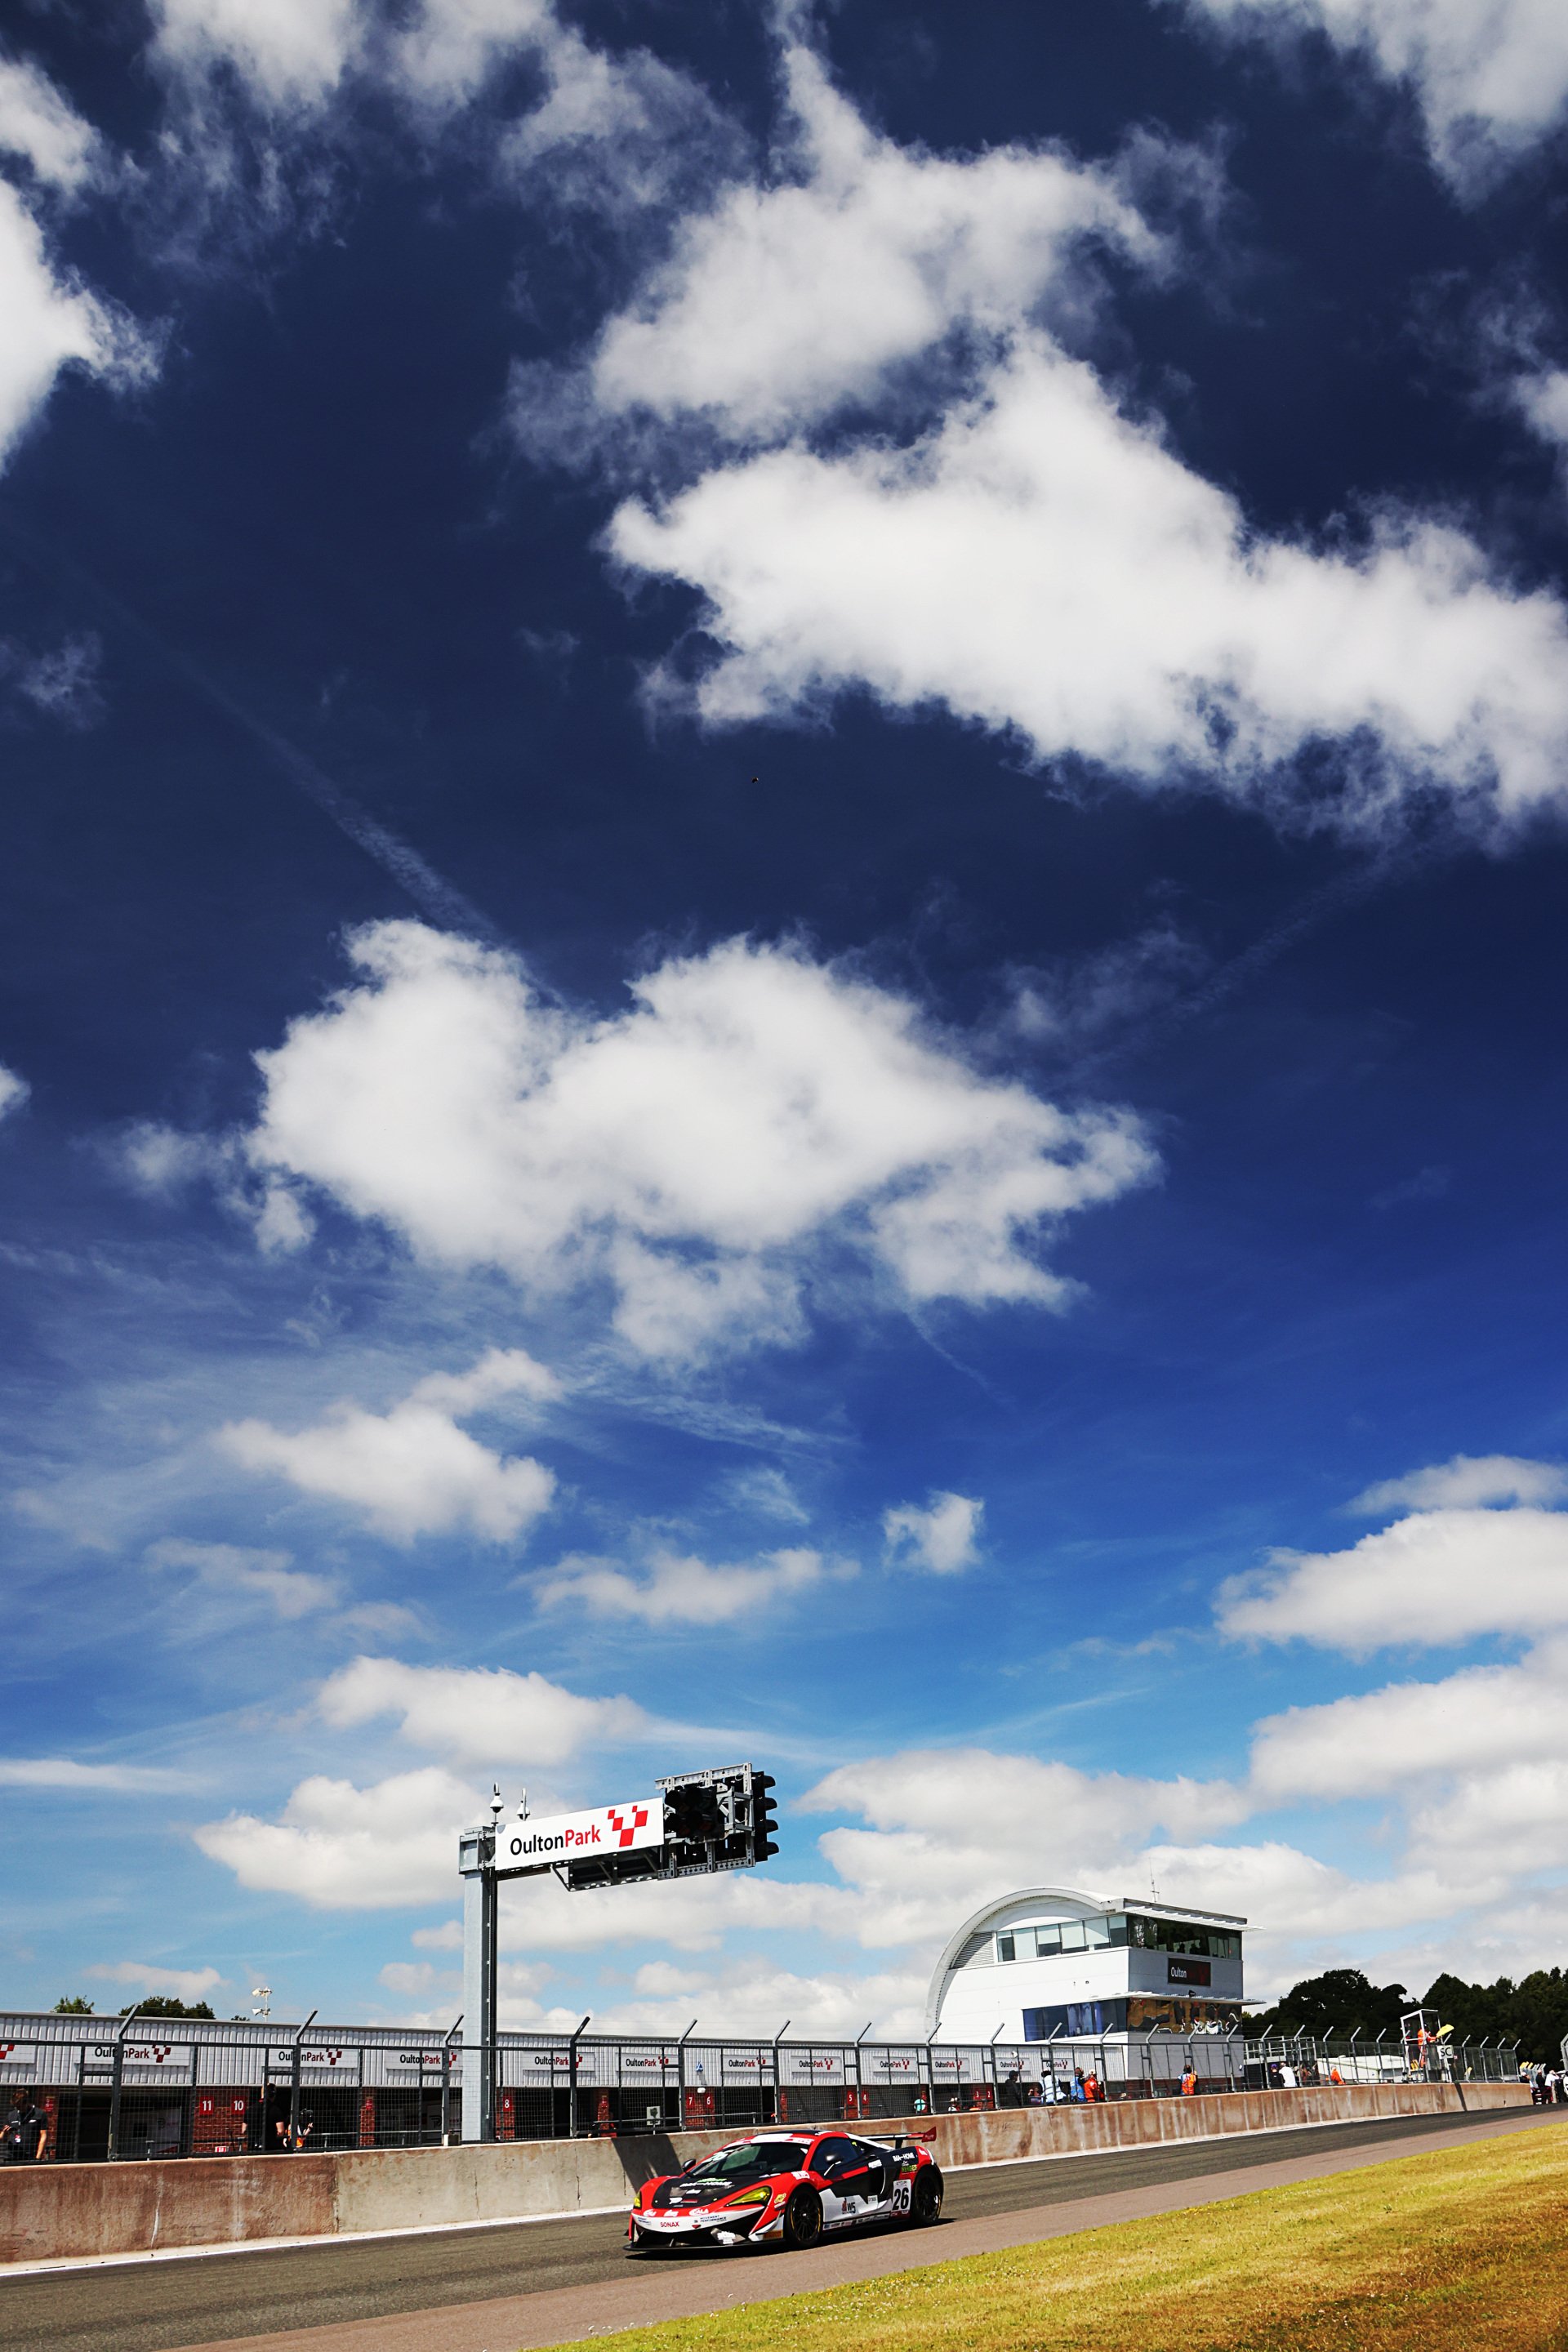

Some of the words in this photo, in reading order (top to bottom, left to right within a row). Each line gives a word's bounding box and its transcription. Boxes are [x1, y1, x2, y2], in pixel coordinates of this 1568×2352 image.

[510, 1824, 601, 1855] OultonPark
[95, 2047, 149, 2058] OultnPark
[278, 2051, 324, 2061] OulnPark
[1440, 2047, 1452, 2056] SC
[626, 2058, 657, 2066] OultonPark
[728, 2059, 755, 2067] OultonPark
[234, 2100, 243, 2110] 10
[505, 2099, 510, 2108] 8
[688, 2096, 693, 2105] 7
[706, 2096, 710, 2105] 6
[203, 2100, 212, 2111] 11
[892, 2187, 909, 2210] 26
